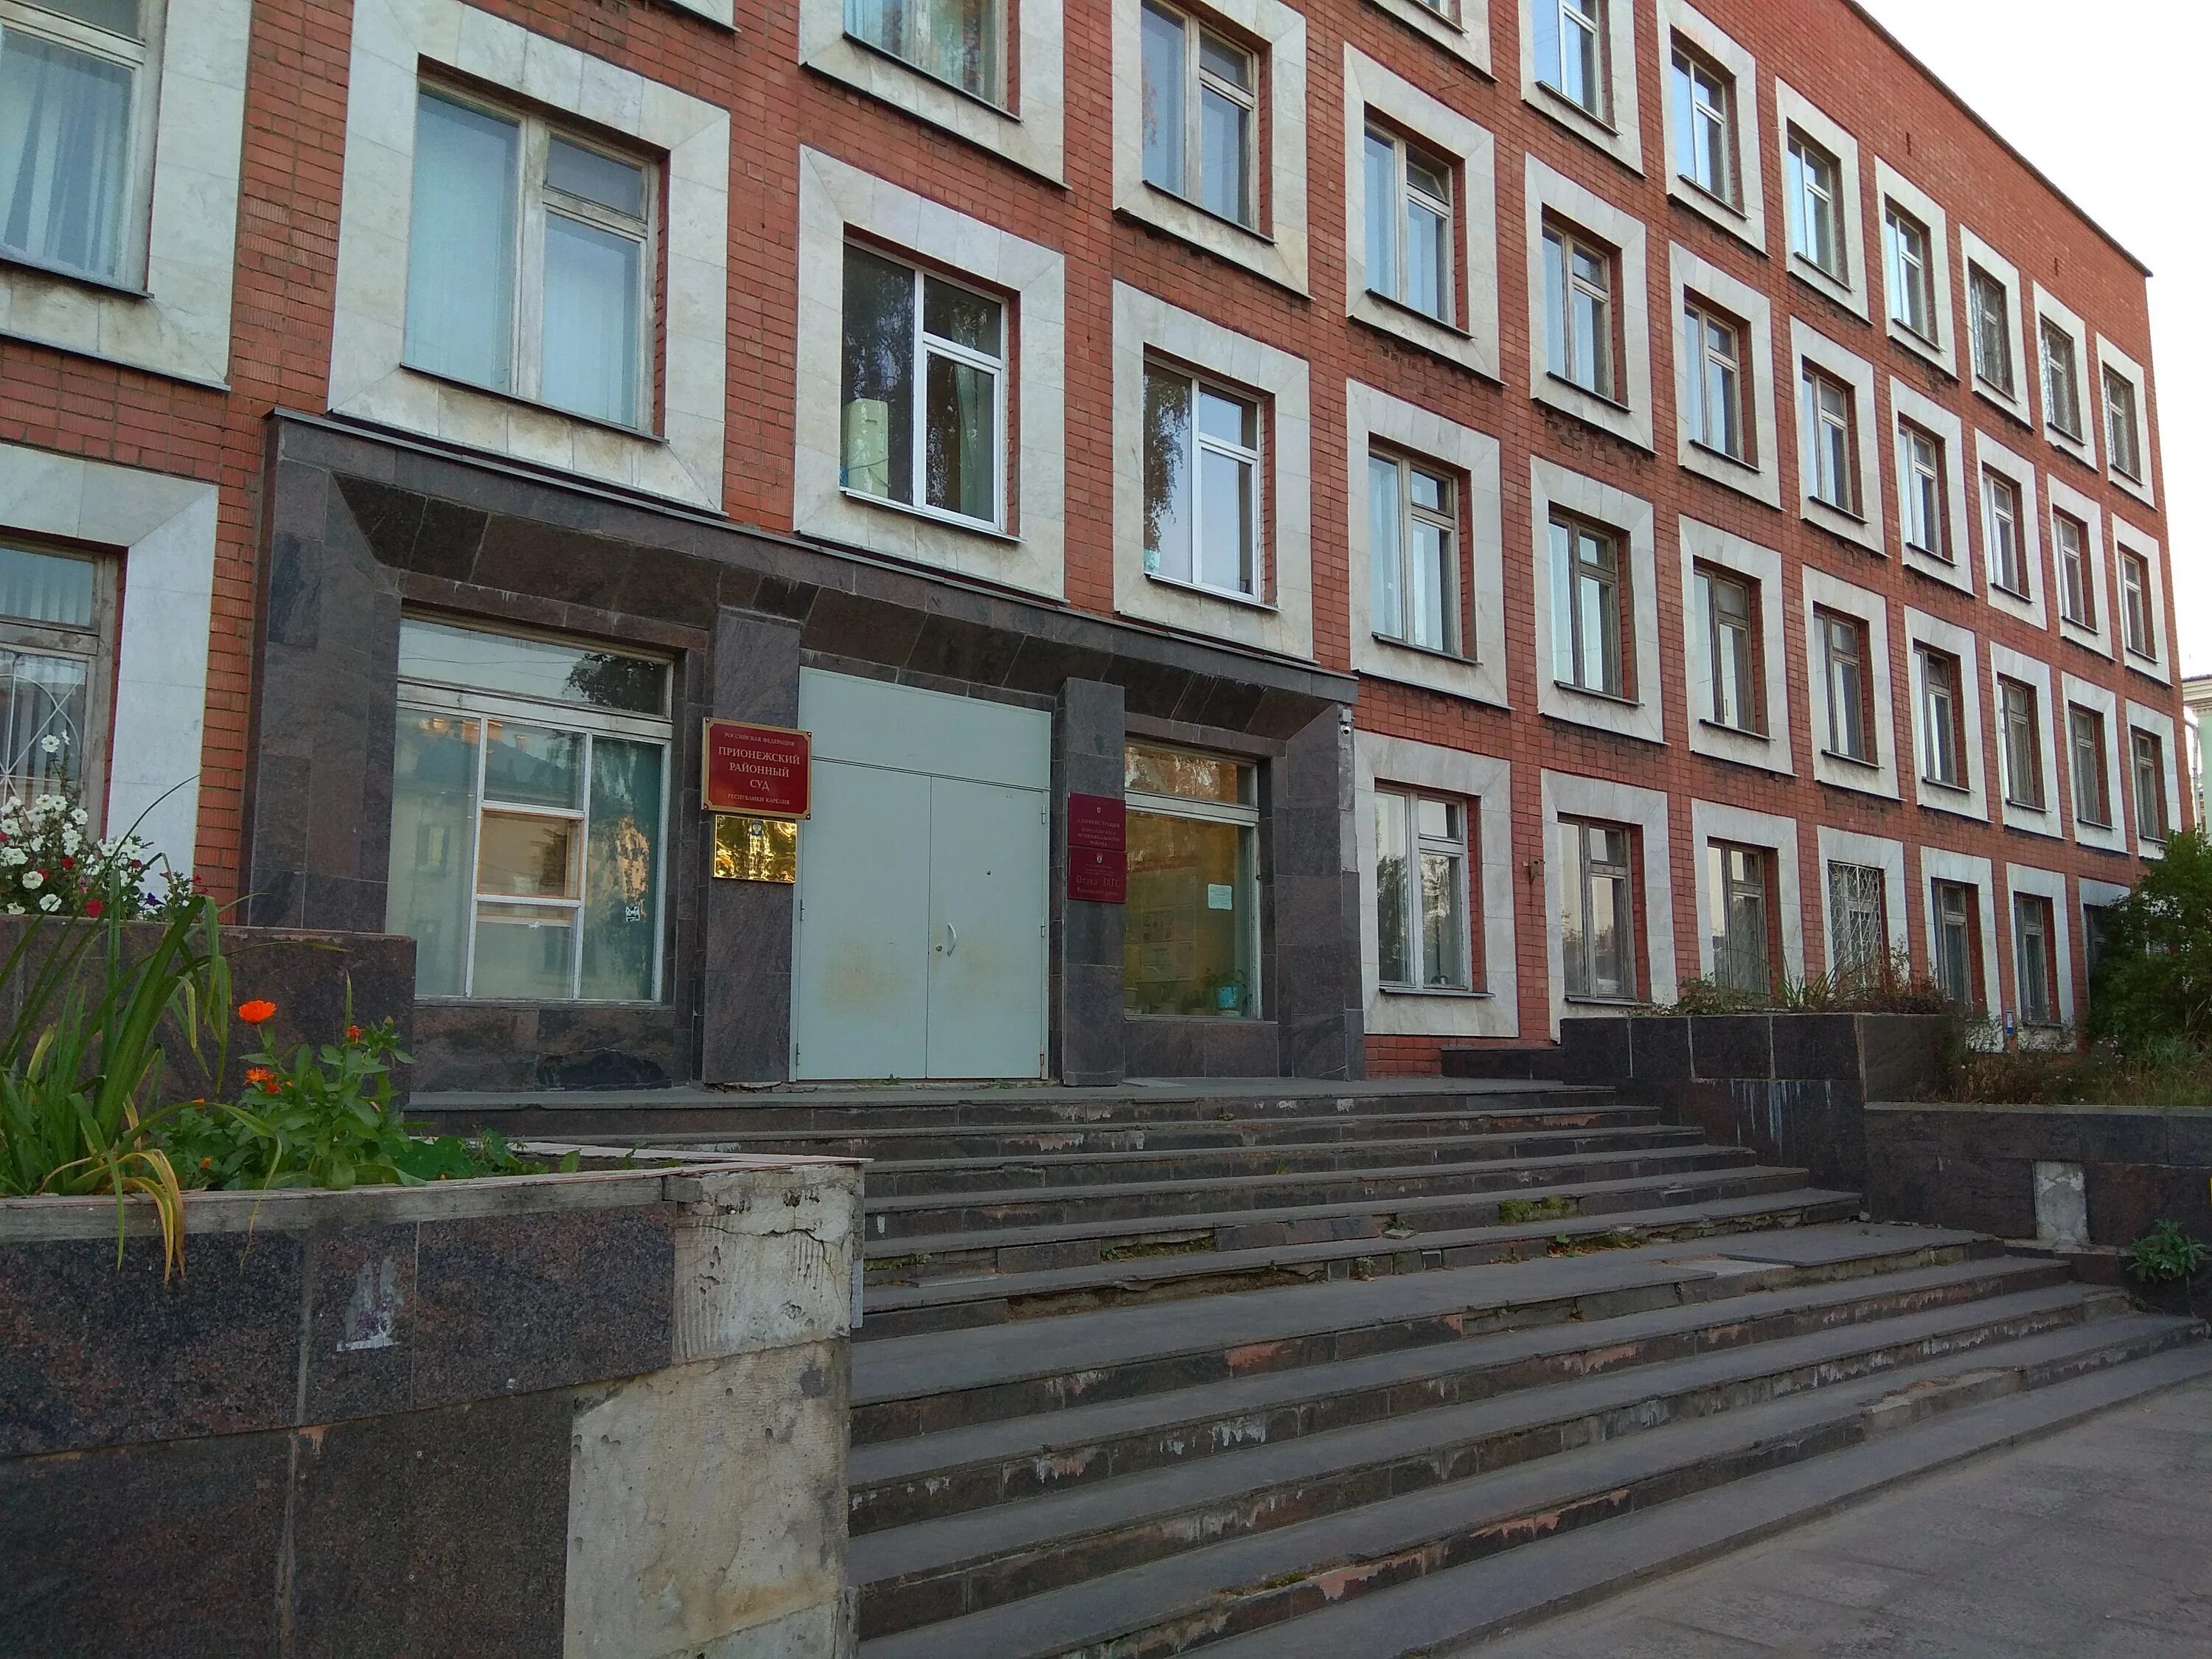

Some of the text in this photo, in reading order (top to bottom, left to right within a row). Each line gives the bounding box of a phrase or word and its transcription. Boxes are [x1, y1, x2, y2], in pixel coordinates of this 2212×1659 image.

[718, 746, 800, 765] ПРИОНЕЖСКИЙ
[729, 762, 790, 778] РАЙОННЫЙ
[750, 779, 769, 791] СУД
[1077, 875, 1121, 888] Отдел ЗАГС
